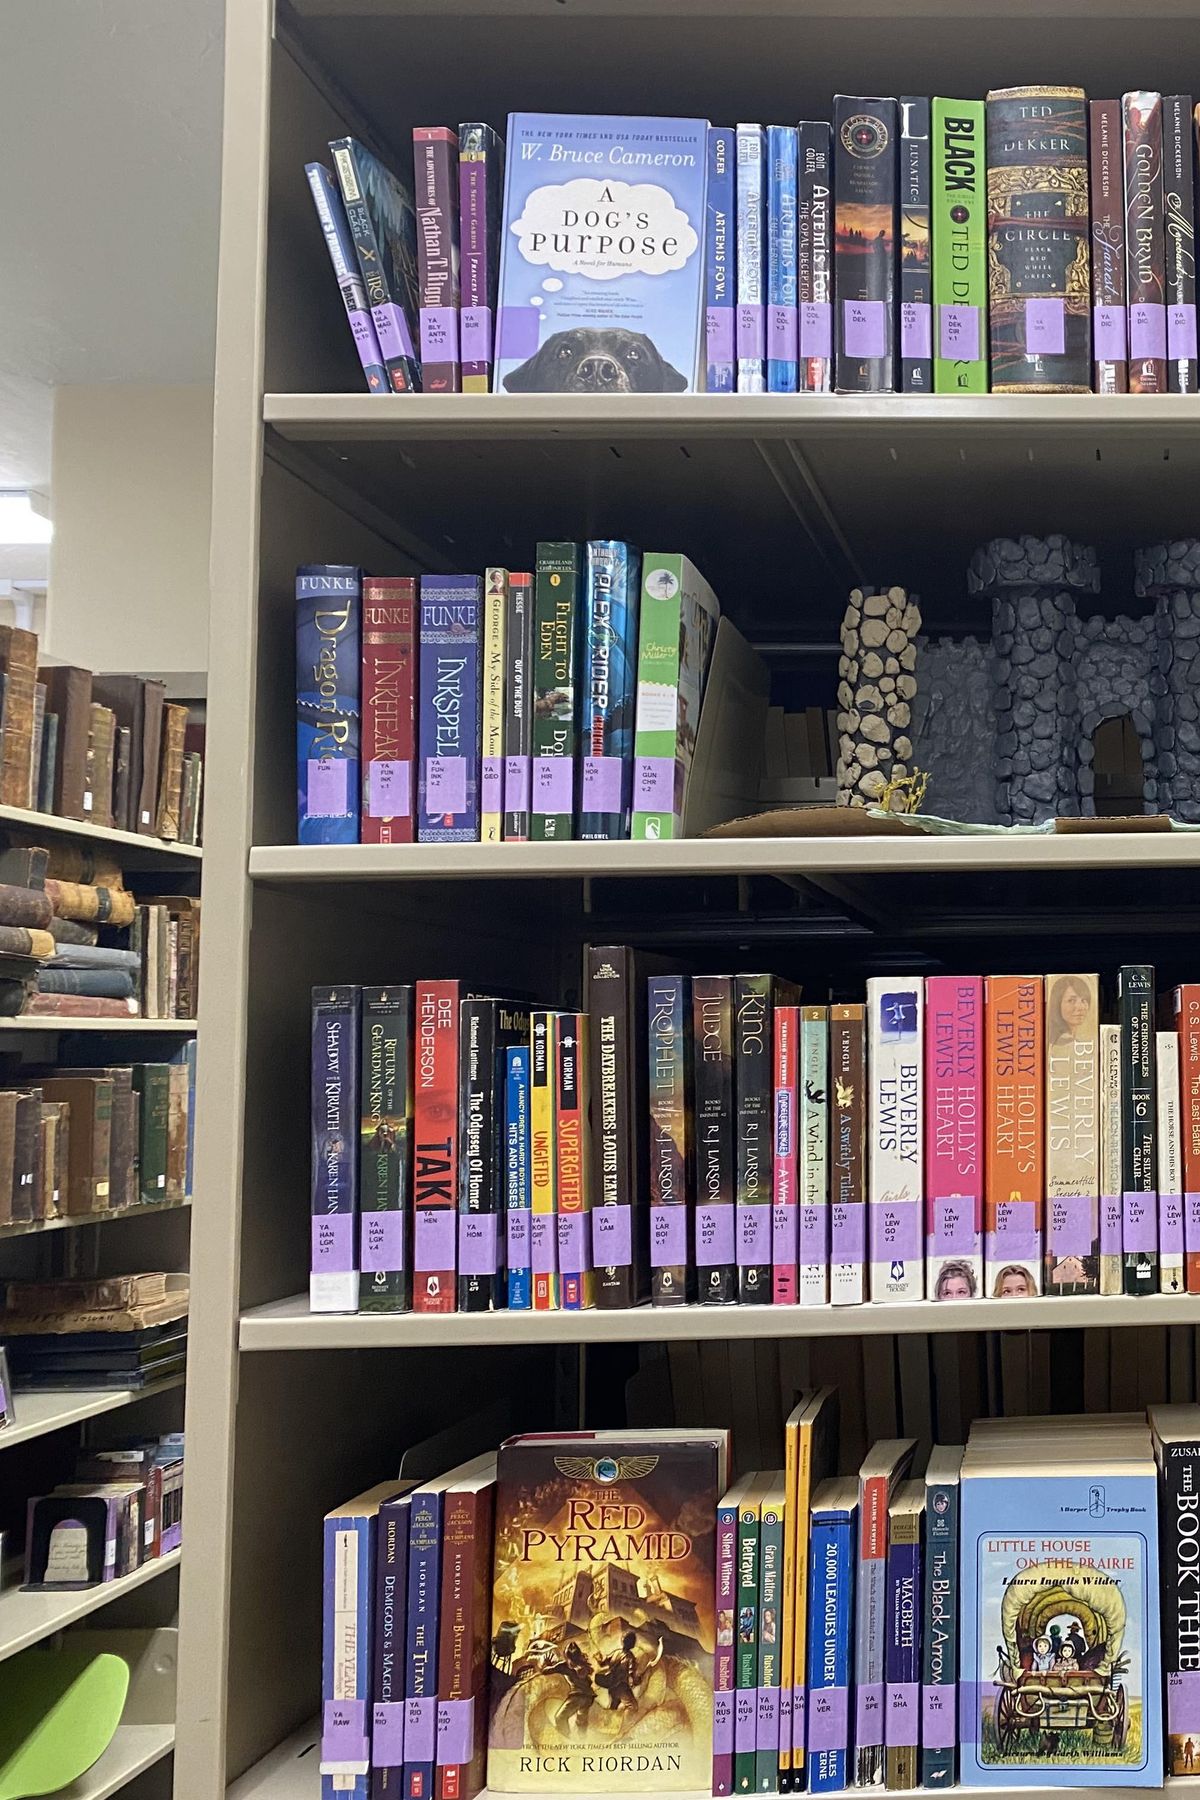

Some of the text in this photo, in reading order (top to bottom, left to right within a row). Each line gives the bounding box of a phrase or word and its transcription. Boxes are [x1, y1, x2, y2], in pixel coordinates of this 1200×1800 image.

[1020, 107, 1052, 118] TED
[521, 143, 696, 167] W. Bruce Cameron
[717, 140, 725, 174] COLFER
[944, 118, 975, 192] BLACK
[1004, 139, 1070, 151] DEKKER
[597, 187, 615, 202] A
[562, 210, 649, 229] DOG'S
[1006, 231, 1070, 241] CIRCLE
[715, 211, 725, 300] ARTEMIS FOWL
[952, 227, 968, 270] TED
[301, 578, 354, 590] FUNKE
[364, 608, 409, 624] FUNKE
[423, 606, 476, 626] FUNKE
[541, 621, 554, 660] EDEN
[556, 602, 570, 680] FLIGHT TO
[439, 998, 451, 1028] DEE
[958, 987, 974, 1078] BEVERLY
[1018, 984, 1035, 1076] BEVERLY
[421, 993, 435, 1088] HENDERSON
[536, 1040, 544, 1072] KORMAN
[936, 1011, 953, 1078] LEWIS
[997, 1011, 1014, 1076] LEWIS
[1189, 1028, 1198, 1062] Lewis
[564, 1056, 573, 1091] KORMAN
[880, 1080, 897, 1150] LEWIS
[900, 1065, 917, 1165] BEVERLY
[936, 1087, 953, 1160] HEART
[997, 1085, 1014, 1158] HEART
[1050, 1056, 1070, 1151] LEWIS
[1074, 1040, 1095, 1166] BEVERLY
[1135, 1102, 1146, 1116] 6
[1191, 1095, 1200, 1119] Last
[958, 1087, 975, 1175] HOLLY'S
[1018, 1085, 1035, 1173] HOLLY'S
[1192, 1123, 1200, 1155] Battle
[509, 1123, 517, 1208] HITS AND MISSES
[535, 1130, 549, 1187] UNGIFTED
[560, 1119, 579, 1210] SUPERGIFTED
[594, 1490, 619, 1500] THE
[1182, 1465, 1192, 1492] THE
[567, 1500, 645, 1531] RED
[520, 1530, 691, 1561] PYRAMID
[988, 1541, 1091, 1552] LITTLE HOUSE
[1176, 1493, 1199, 1586] BOOK
[721, 1532, 734, 1595] Silent Witness
[742, 1537, 756, 1588] Betrayed
[1002, 1576, 1121, 1588] Laura Ingalls Wilder
[1016, 1558, 1134, 1569] ON THE PRAIRIE
[383, 1576, 395, 1638] DEMIGODS
[824, 1543, 837, 1680] 20,000 LEAGUES UNDER
[902, 1577, 913, 1648] MACBETH
[520, 1755, 681, 1773] RICK RIORDAN
